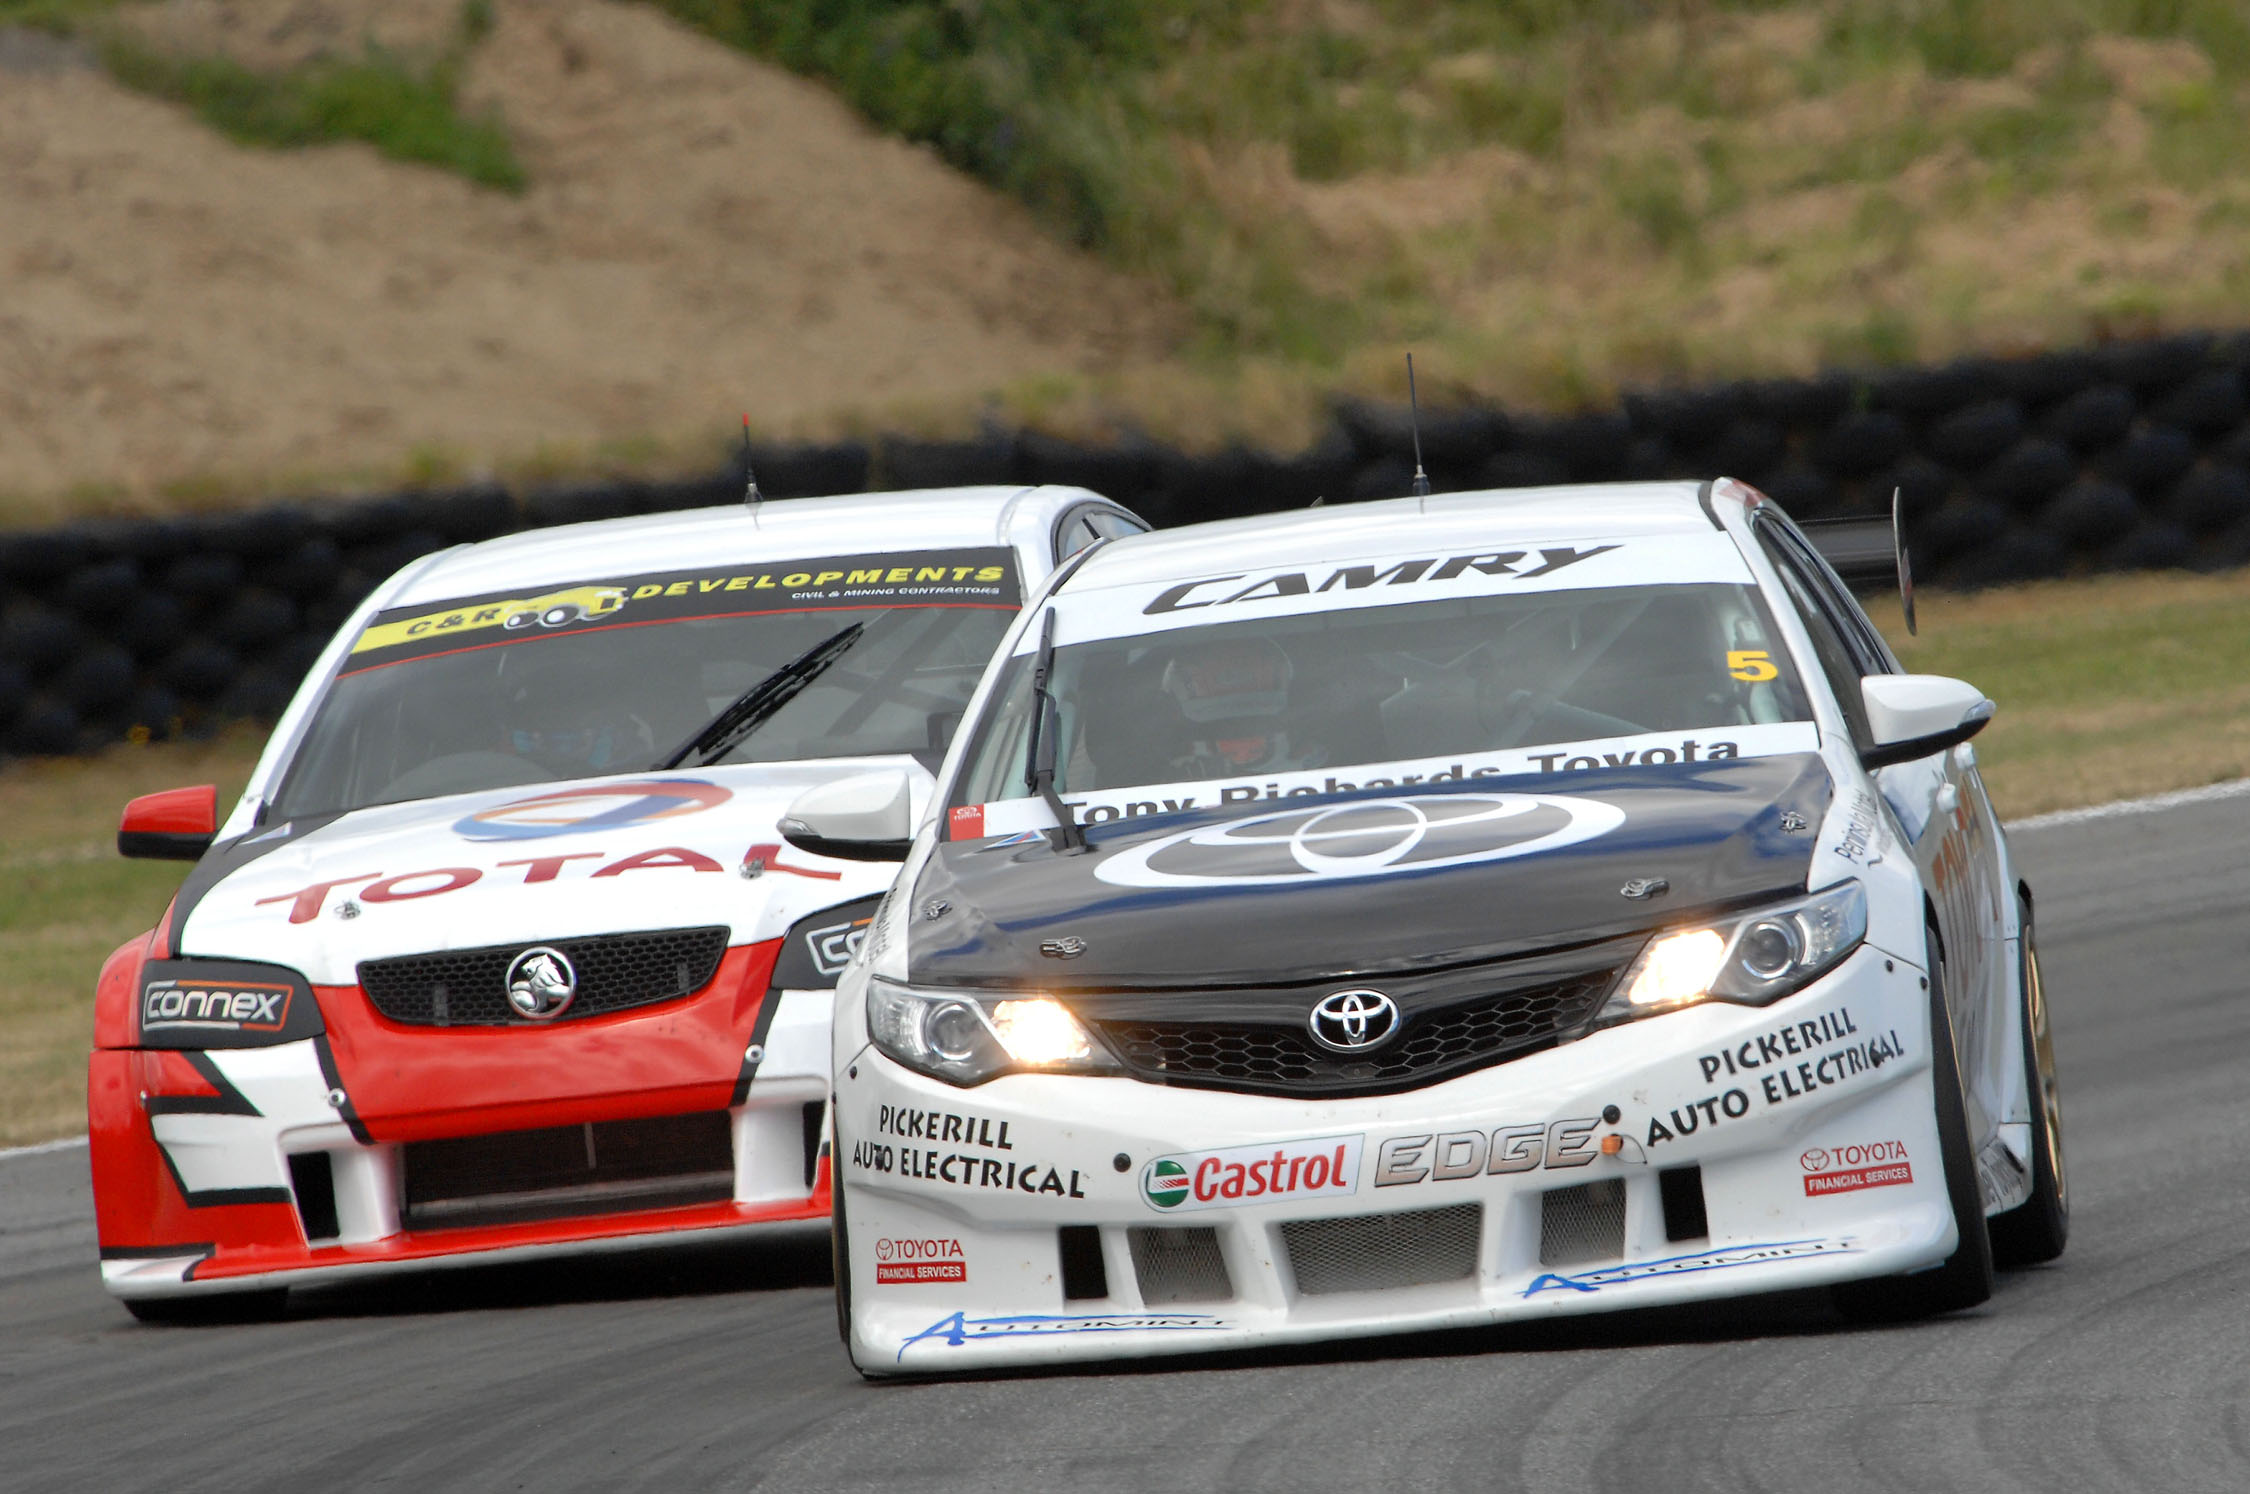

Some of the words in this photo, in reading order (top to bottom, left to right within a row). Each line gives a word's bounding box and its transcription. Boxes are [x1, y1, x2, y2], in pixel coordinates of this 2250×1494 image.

[631, 566, 1004, 600] DEVELOPMENTS
[791, 591, 825, 600] CIVIL
[844, 588, 895, 597] MINING
[898, 586, 1001, 596] CONTRACTORS
[1142, 545, 1625, 615] CAMRY
[1727, 650, 1778, 682] 5
[1527, 740, 1739, 772] Toyota
[255, 842, 841, 924] TOTAL
[147, 991, 282, 1021] connex
[1699, 1007, 1857, 1083] PICKERILL
[1647, 1088, 1749, 1147] AUTO
[1761, 1030, 1905, 1105] ELECTRICAL
[880, 1104, 1013, 1150] PICKERILL
[853, 1140, 893, 1173] AUTO
[901, 1148, 1085, 1198] ELECTRICAL
[1375, 1118, 1602, 1187] EDGE
[1831, 1140, 1909, 1166] TOYOTA
[1194, 1143, 1347, 1202] Castrol
[1808, 1174, 1865, 1192] FINANCIAL
[1865, 1167, 1909, 1183] SERVICES
[895, 1239, 964, 1259] TOYOTA
[879, 1267, 915, 1280] FINANCIAL
[916, 1265, 962, 1279] SERVICES
